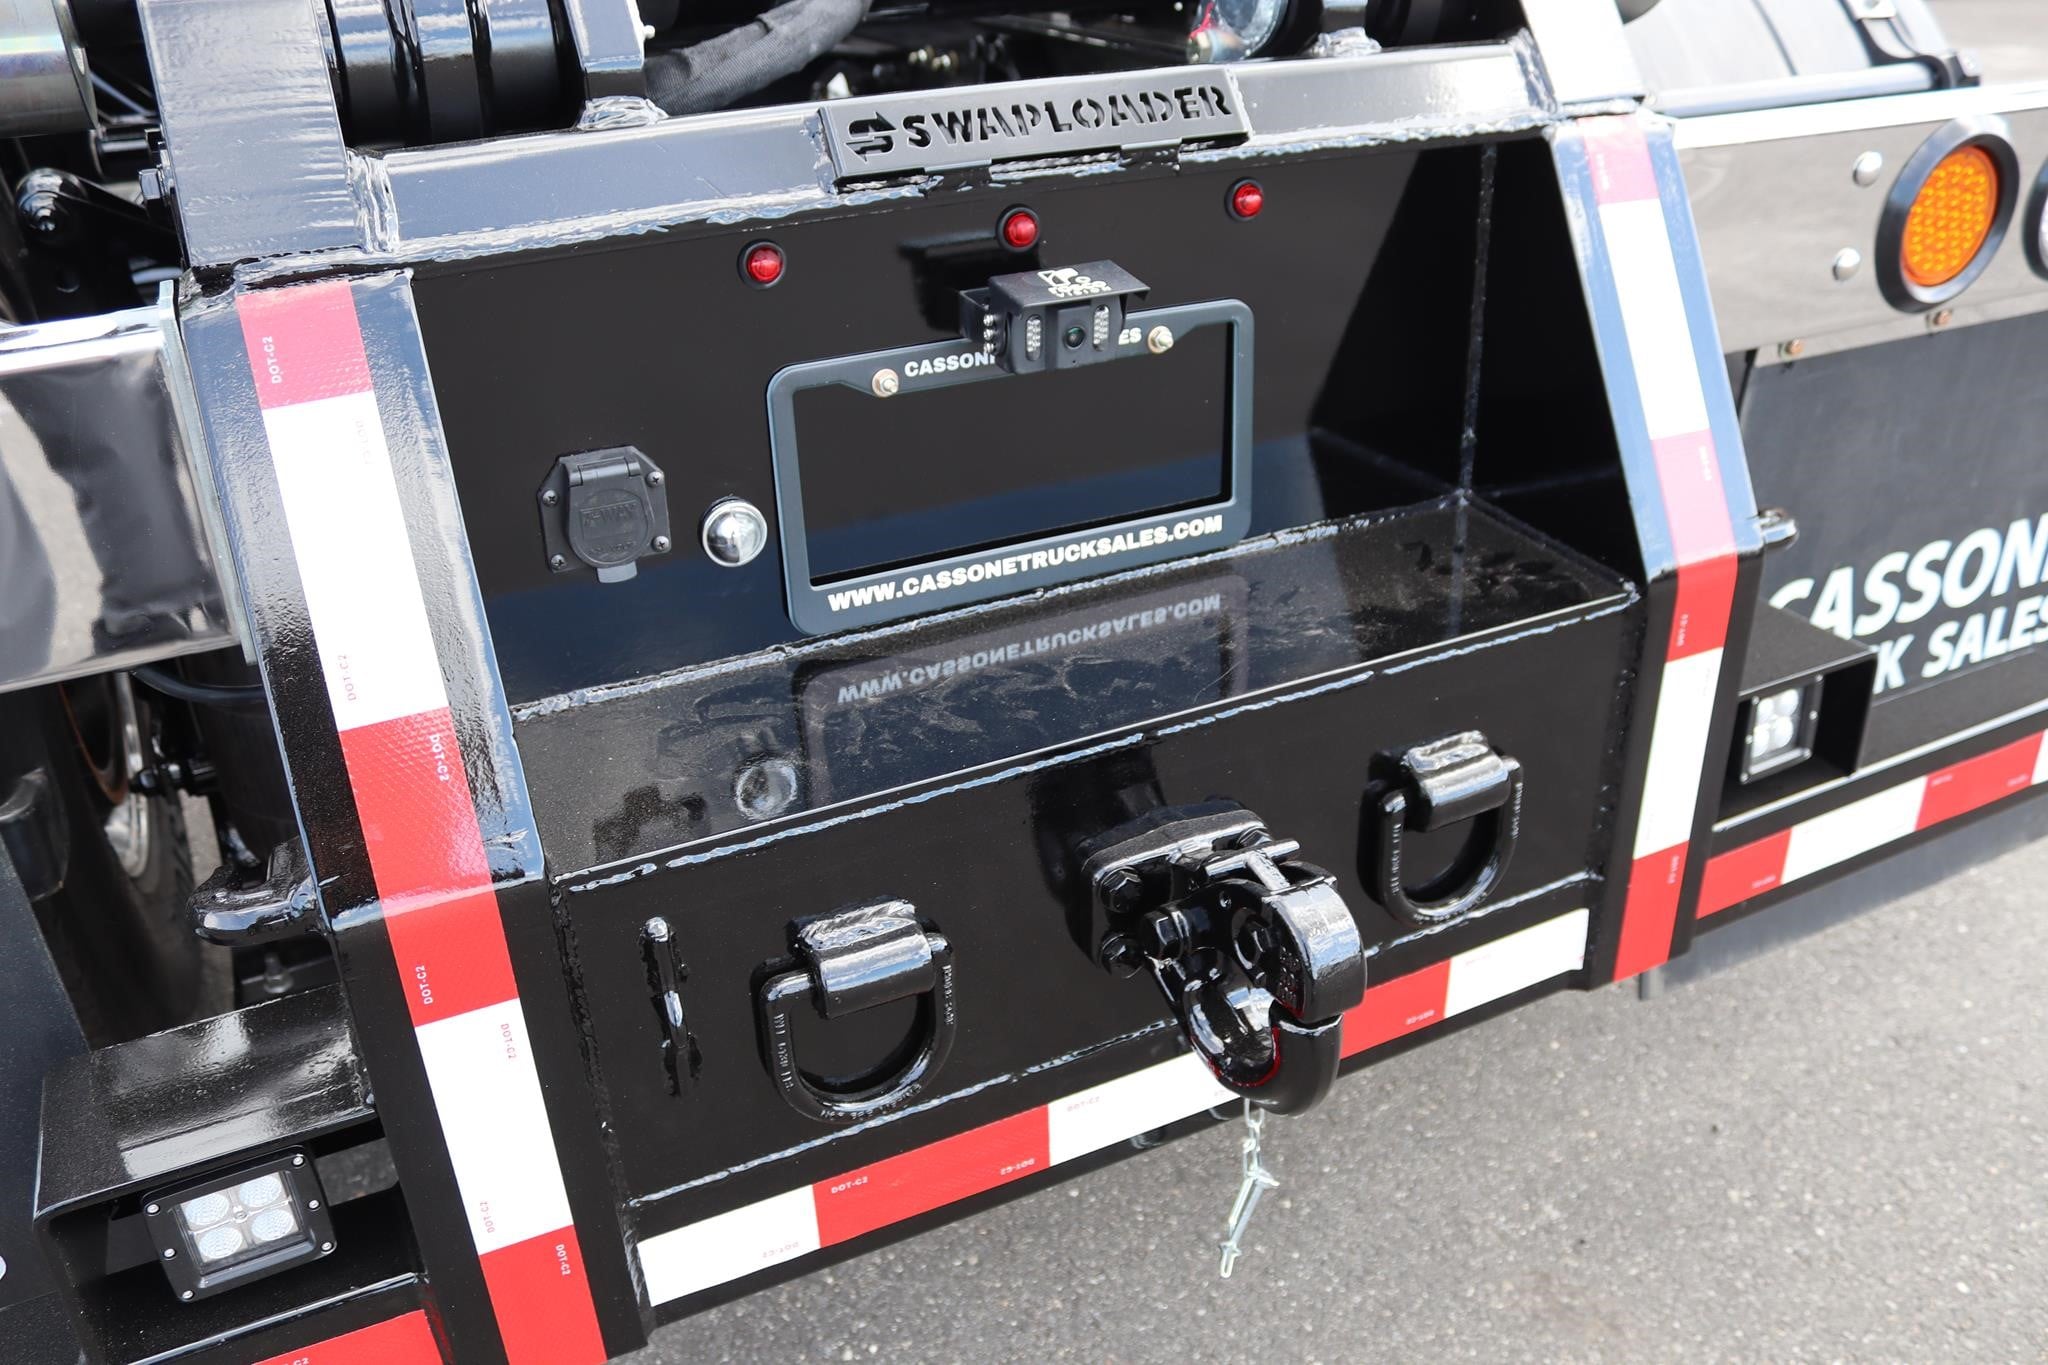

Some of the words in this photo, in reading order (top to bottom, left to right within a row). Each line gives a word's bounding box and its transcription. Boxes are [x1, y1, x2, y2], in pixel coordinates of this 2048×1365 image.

[902, 85, 1232, 149] SWAPLOADER
[262, 335, 282, 384] DOT-C2
[827, 514, 1223, 612] WWW.CASSONETRUCKSALES.COM
[1768, 511, 2048, 640] ASSON
[429, 733, 449, 781] DOT-C2
[415, 965, 433, 1005] DOT-C2
[500, 1023, 517, 1059] DOT-C2
[831, 1176, 868, 1194] DOT-C2
[555, 1243, 572, 1276] DOT-C2
